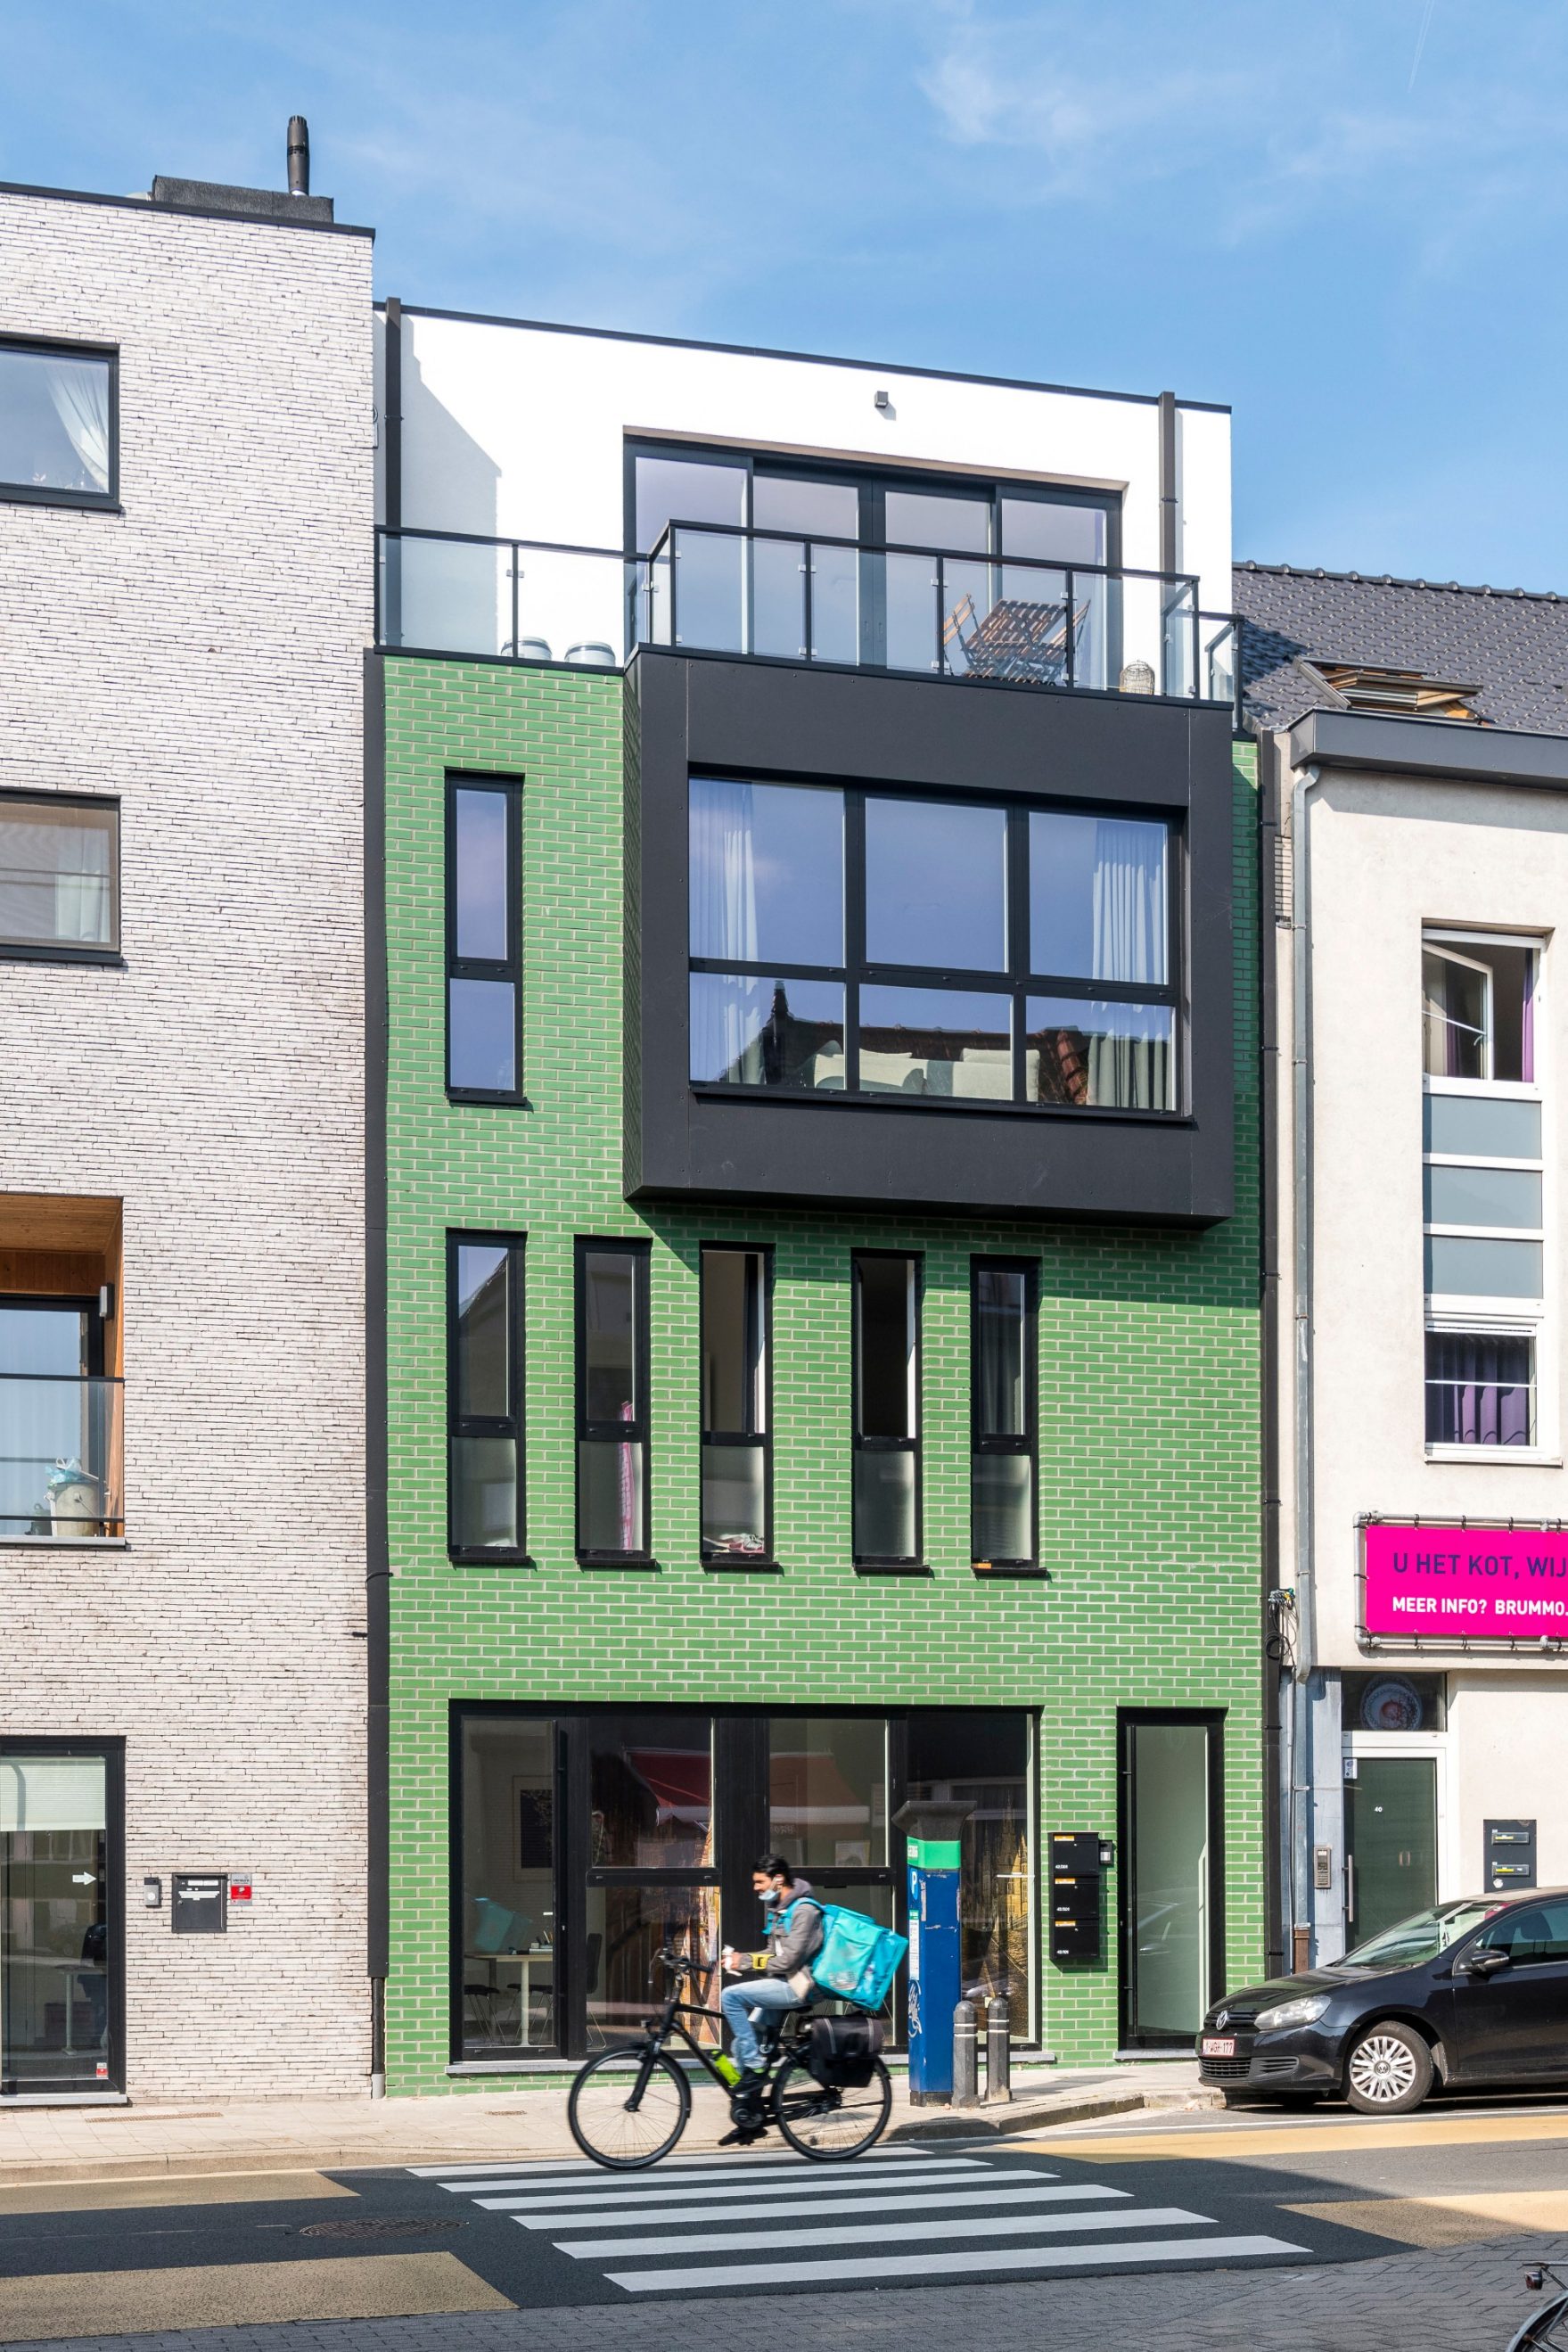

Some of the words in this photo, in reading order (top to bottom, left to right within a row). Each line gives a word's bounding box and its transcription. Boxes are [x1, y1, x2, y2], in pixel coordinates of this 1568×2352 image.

[1393, 1552, 1408, 1573] U
[1416, 1553, 1461, 1575] HET
[1468, 1555, 1519, 1580] KOT,
[1526, 1557, 1567, 1578] WIJ
[1392, 1597, 1437, 1613] MEER
[1441, 1598, 1487, 1615] INFO?
[1495, 1600, 1568, 1616] BRUMMO.
[912, 1871, 917, 1894] P
